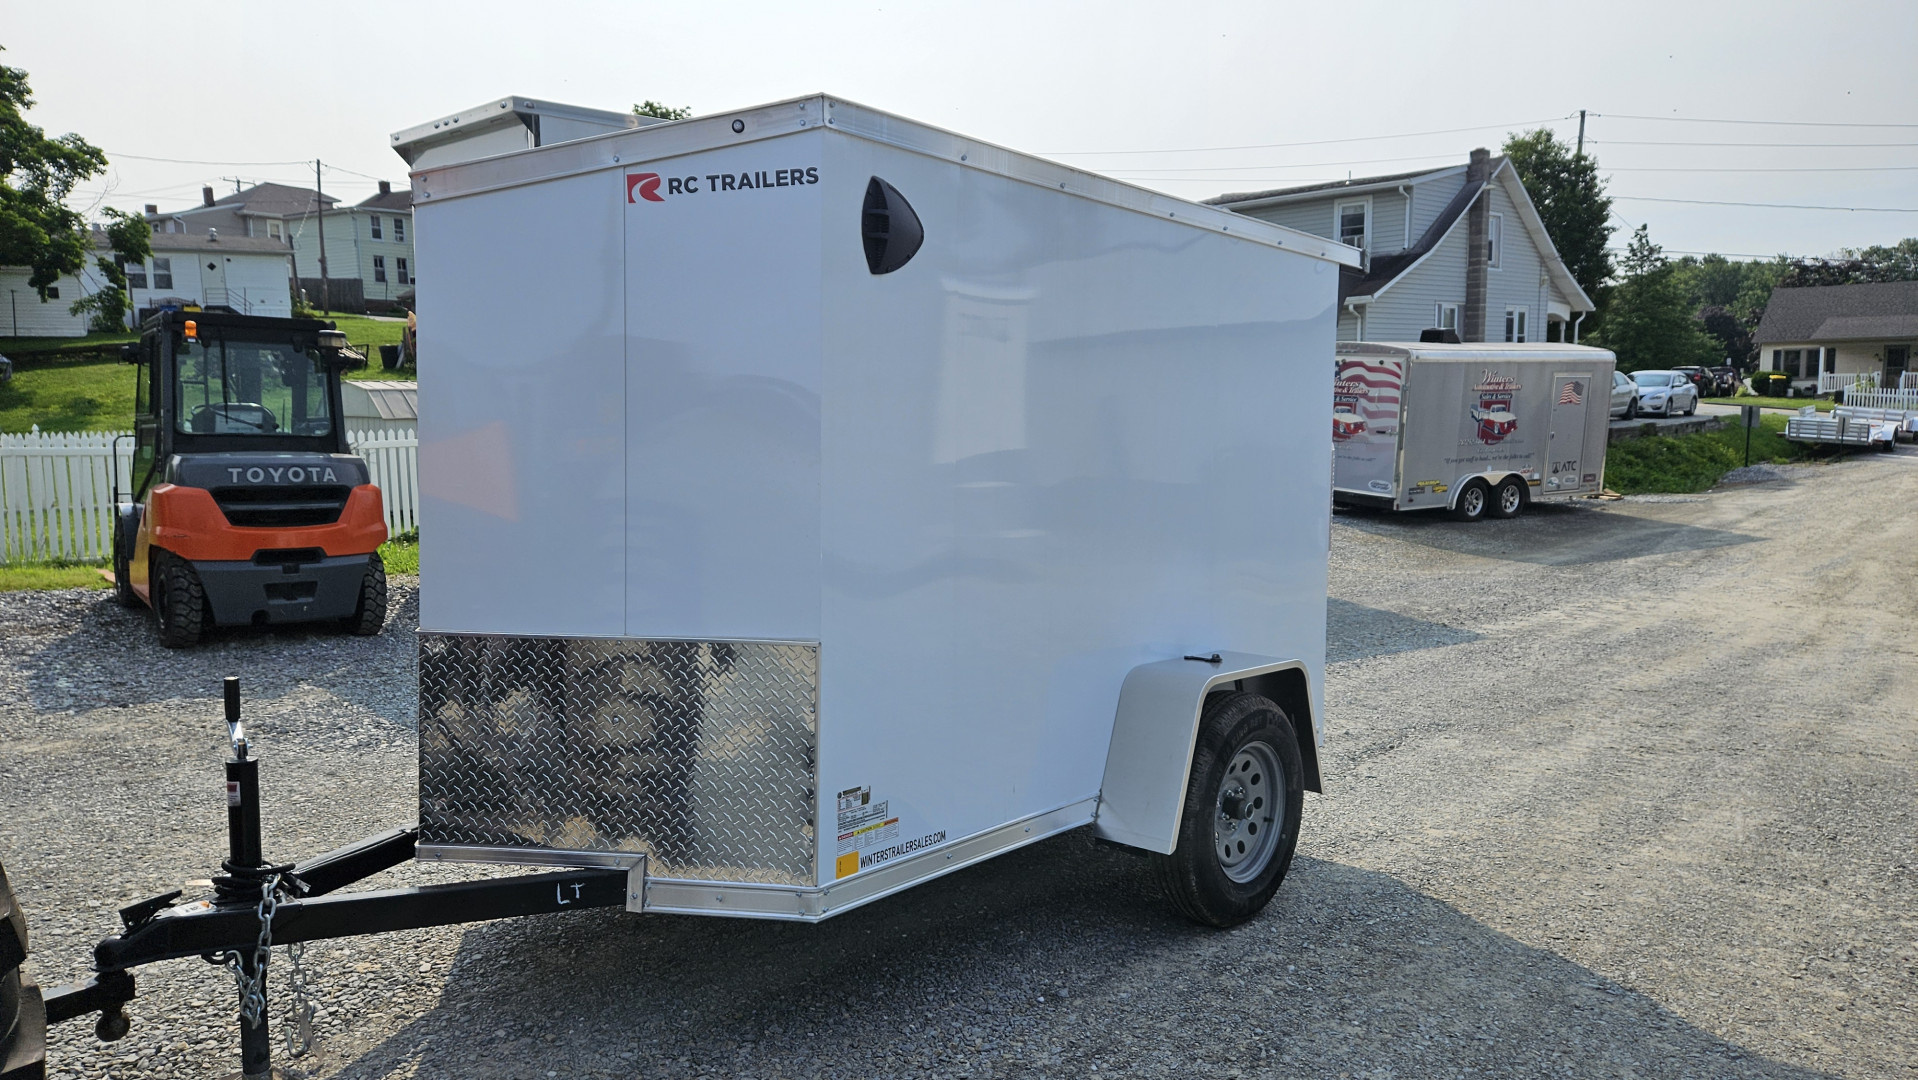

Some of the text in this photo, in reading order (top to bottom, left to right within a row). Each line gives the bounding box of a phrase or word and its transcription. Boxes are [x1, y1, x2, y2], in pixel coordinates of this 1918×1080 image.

[667, 175, 699, 195] RC
[705, 166, 820, 192] TRAILERS
[1334, 375, 1361, 388] inters
[1482, 368, 1514, 384] Winters
[228, 466, 338, 484] TOYOTA
[1561, 461, 1577, 472] ATC
[860, 830, 947, 868] WINTERSTRAILERSALES.COM
[556, 882, 586, 905] LT
